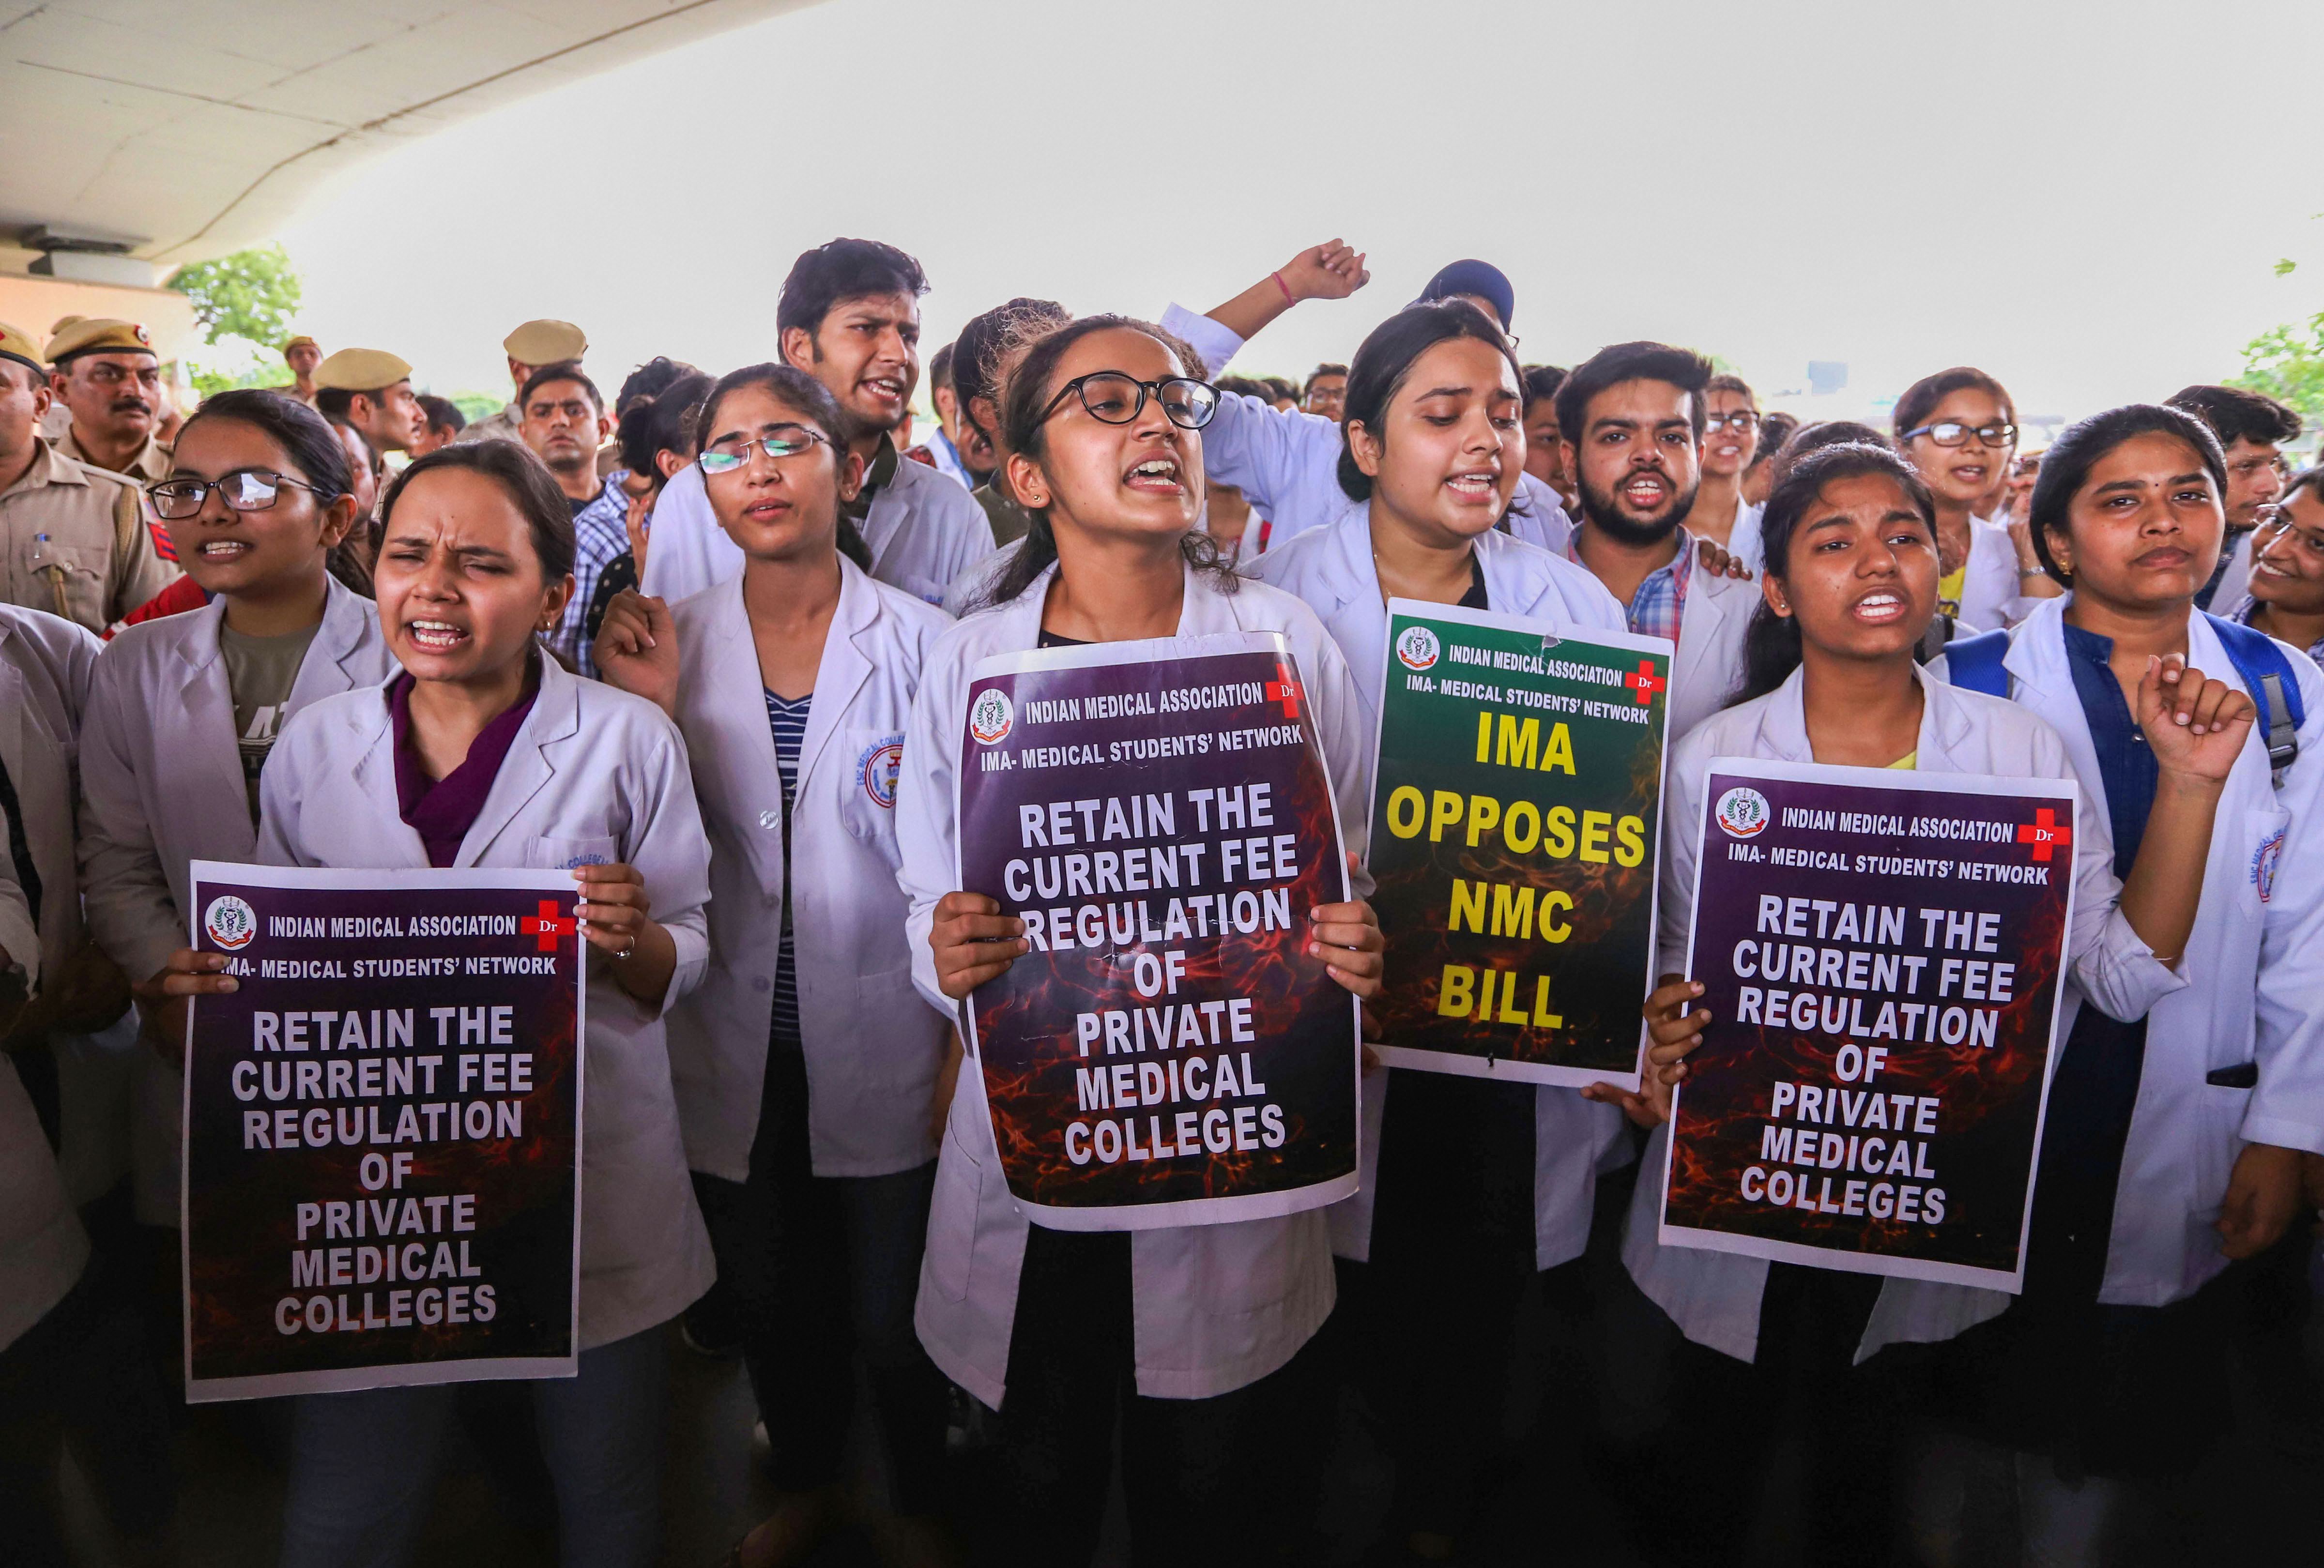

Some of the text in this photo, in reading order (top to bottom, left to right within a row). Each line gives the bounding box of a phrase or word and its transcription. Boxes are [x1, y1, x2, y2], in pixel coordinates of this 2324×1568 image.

[1449, 645, 1491, 667] INDIAN
[1494, 651, 1544, 674] MEDICAL
[1547, 659, 1622, 687] ASSOCIATION
[1638, 677, 1652, 687] Dr
[1026, 682, 1262, 724] INDIAN MEDICAL ASSOCIATION
[1281, 685, 1294, 696] Dr
[1407, 675, 1649, 724] IMA- MEDICAL STUDENTS' NETWORK
[857, 742, 881, 768] MEDICAL
[981, 725, 1303, 771] IMA- MEDICAL STUDENTS' NETWORK
[1477, 712, 1575, 775] IMA
[1020, 783, 1273, 848] RETAIN THE
[1387, 786, 1644, 867] OPPOSES
[1782, 807, 1835, 830] INDIAN
[1839, 812, 1905, 836] MEDICAL
[1909, 817, 2013, 843] ASSOCIATION
[2035, 829, 2053, 840] Dr
[1005, 834, 1298, 901] CURRENT FEE
[1728, 843, 2049, 885] IMA- MEDICAL STUDENTS' NETWORK
[270, 915, 515, 937] INDIAN MEDICAL ASSOCIATION
[539, 921, 557, 931] Dr
[1020, 887, 1290, 953] REGULATION
[1449, 879, 1573, 943] NMC
[1757, 895, 2000, 952] RETAIN THE
[221, 957, 556, 978] MA- MEDICAL STUDENTS' NETWORK
[1134, 950, 1185, 997] OF
[1733, 940, 2015, 1001] CURRENT FEE
[1438, 965, 1562, 1029] BILL
[1737, 987, 1998, 1047] REGULATION
[255, 1006, 513, 1051] RETAIN THE
[1077, 998, 1254, 1057] PRIVATE
[232, 1054, 532, 1101] CURRENT FEE
[1076, 1053, 1265, 1111] MEDICAL
[1836, 1044, 1888, 1082] OF
[244, 1101, 521, 1149] REGULATION
[1772, 1081, 1939, 1133] PRIVATE
[1066, 1104, 1285, 1164] COLLEGES
[1761, 1125, 1936, 1178] MEDICAL
[360, 1152, 413, 1190] OF
[297, 1194, 475, 1240] PRIVATE
[1741, 1166, 1945, 1224] COLLEGES
[292, 1240, 480, 1287] MEDICAL
[275, 1285, 496, 1335] COLLEGES
